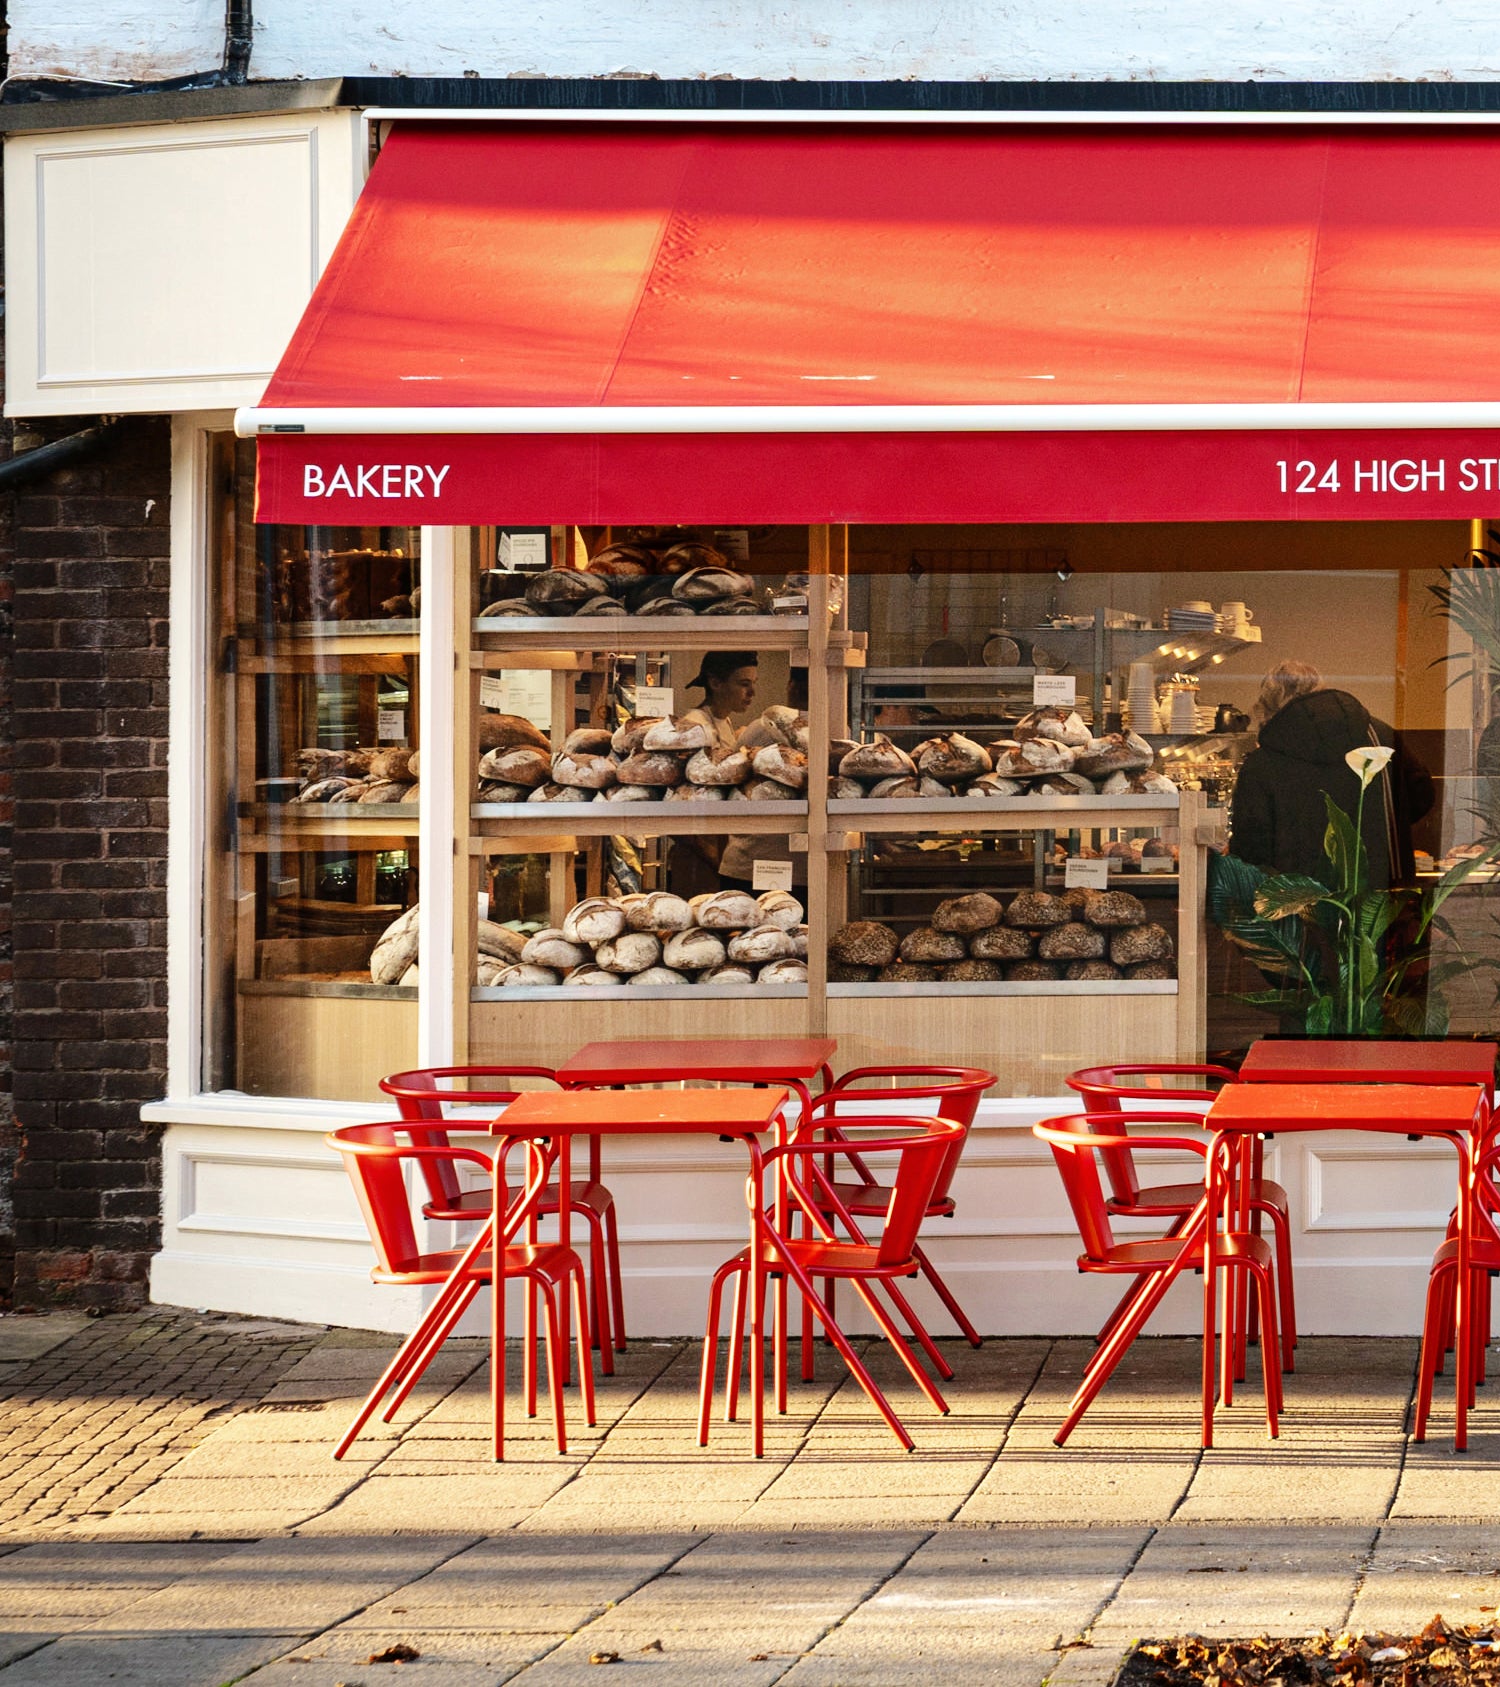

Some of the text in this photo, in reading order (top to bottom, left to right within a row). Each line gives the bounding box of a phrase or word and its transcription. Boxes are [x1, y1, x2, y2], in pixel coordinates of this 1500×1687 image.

[303, 464, 450, 498] BAKERY
[1276, 458, 1341, 492] 124
[1354, 457, 1445, 492] HIGH
